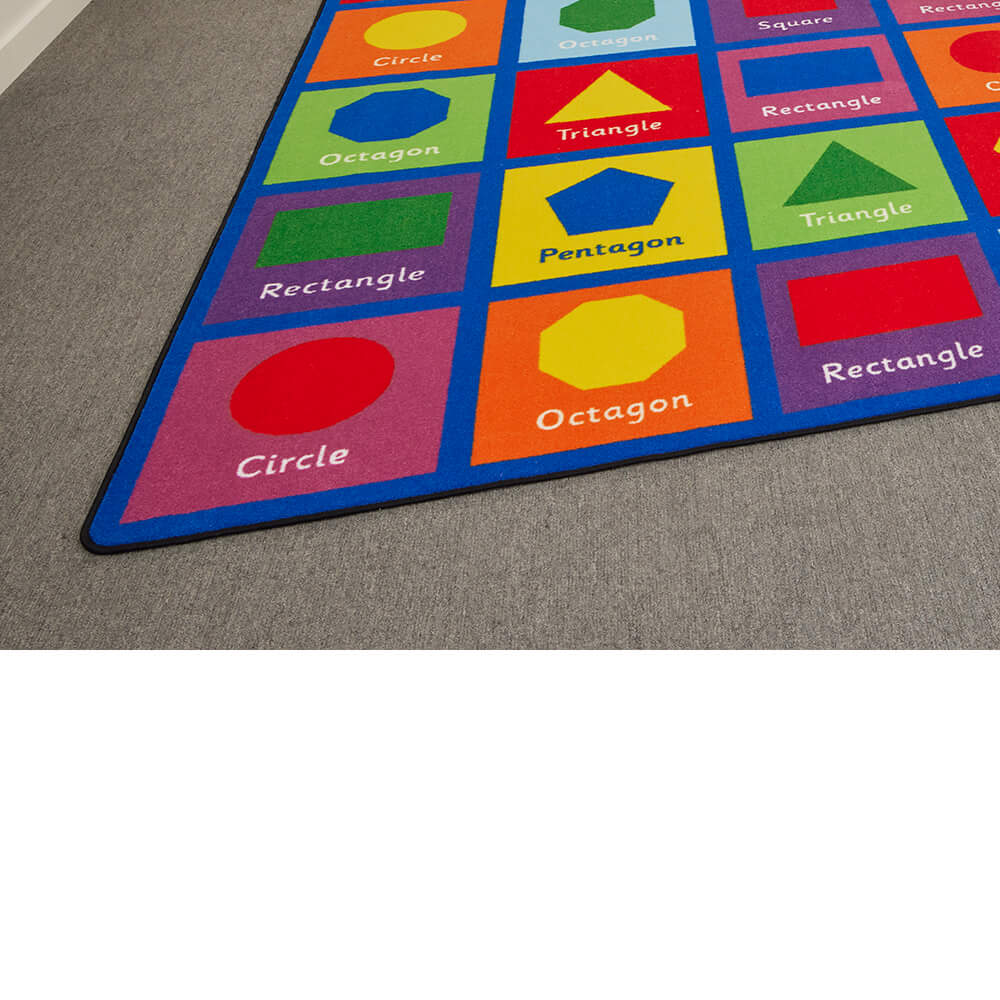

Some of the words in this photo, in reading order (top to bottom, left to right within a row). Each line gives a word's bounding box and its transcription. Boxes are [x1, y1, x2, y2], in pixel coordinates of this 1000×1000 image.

[757, 16, 833, 31] Square
[558, 31, 659, 52] Octagon
[372, 51, 444, 69] Circle
[761, 94, 882, 118] Rectangle
[556, 119, 662, 141] Triangle
[319, 145, 441, 167] Octagon
[799, 201, 913, 228] Triangle
[538, 229, 687, 265] Pentagon
[259, 266, 425, 300] Rectangle
[821, 341, 984, 384] Rectangle
[535, 394, 693, 431] Octagon
[236, 444, 350, 478] Circle
